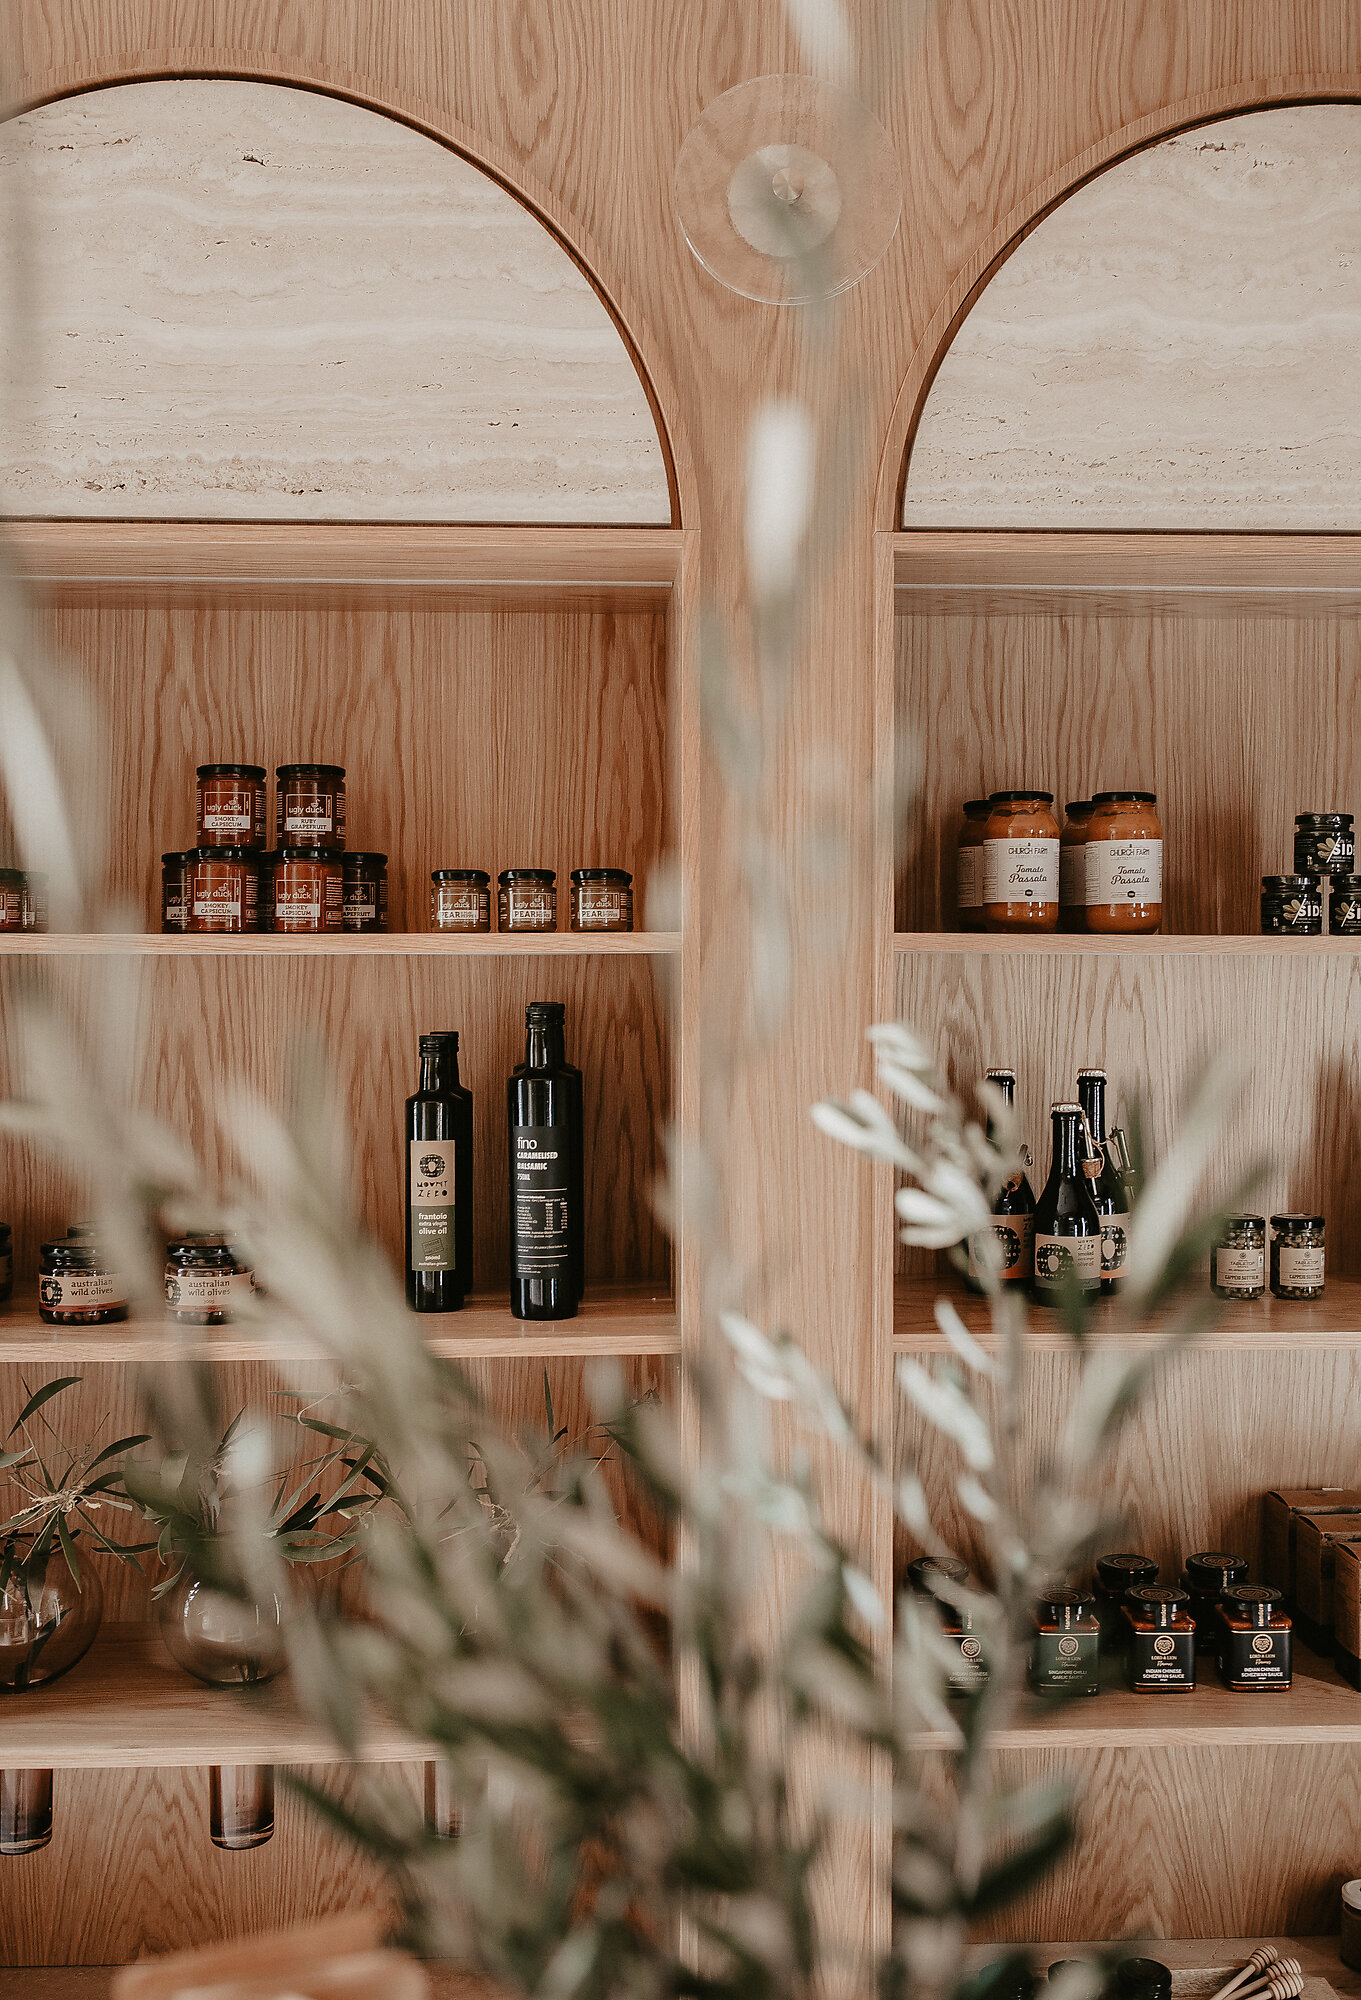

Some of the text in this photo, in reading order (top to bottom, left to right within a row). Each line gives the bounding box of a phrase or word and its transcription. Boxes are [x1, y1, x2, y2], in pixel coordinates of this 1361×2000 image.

[207, 804, 221, 812] ugly
[288, 806, 304, 814] ugly
[1110, 848, 1135, 856] CHURCH
[1016, 864, 1044, 873] Tomato
[1118, 866, 1146, 874] Tomato
[1008, 873, 1047, 883] Passata
[1111, 875, 1150, 885] Passata
[196, 890, 211, 899] ugly
[279, 892, 291, 900] ugly
[517, 1136, 537, 1150] fino
[71, 1279, 113, 1288] australian
[188, 1279, 230, 1288] australian
[71, 1287, 113, 1296] wild olives
[188, 1288, 231, 1296] wild olives
